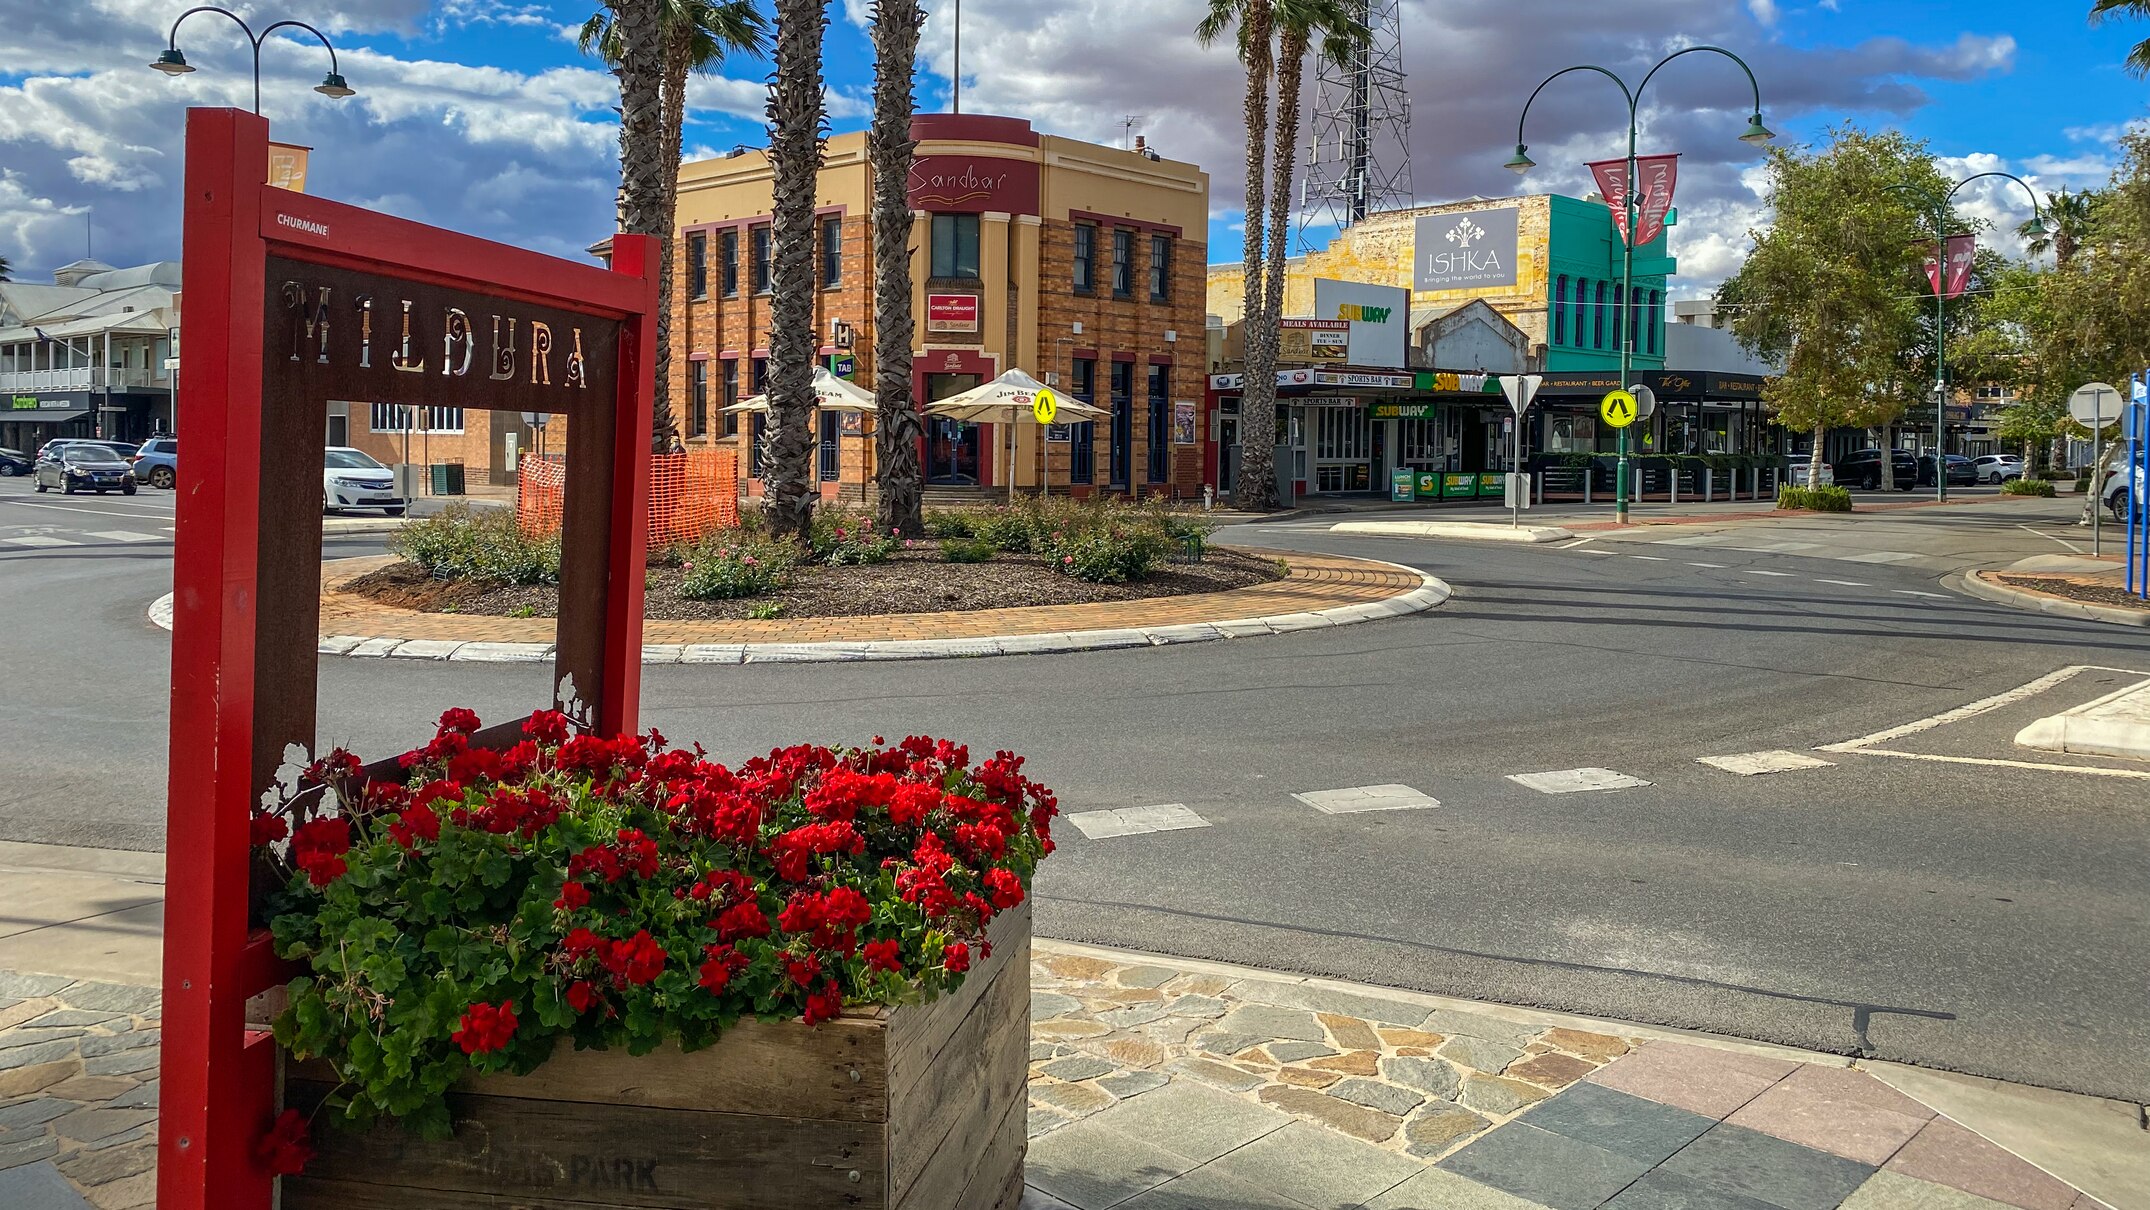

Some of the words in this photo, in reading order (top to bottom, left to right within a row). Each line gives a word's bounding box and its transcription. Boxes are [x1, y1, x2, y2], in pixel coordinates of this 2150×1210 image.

[906, 157, 1006, 192] Sandbar
[277, 213, 328, 236] CHURMANE
[1428, 249, 1501, 275] ISHKA
[1424, 275, 1450, 284] Bringing
[1463, 273, 1482, 281] world
[1492, 272, 1506, 280] you
[1337, 303, 1392, 324] SUBWAY
[1283, 320, 1307, 328] MEALS
[1308, 321, 1348, 329] AVAILABLE
[281, 279, 588, 390] MILDURA
[837, 325, 849, 343] H
[837, 363, 852, 373] TAB
[1347, 375, 1369, 383] SPORTS
[1432, 372, 1488, 393] SUBWAY
[1605, 380, 1622, 388] GARD
[996, 391, 1015, 399] JIM
[1375, 404, 1429, 417] SUBWAY
[1445, 475, 1475, 486] SUBWAY
[570, 1152, 662, 1194] PARK
